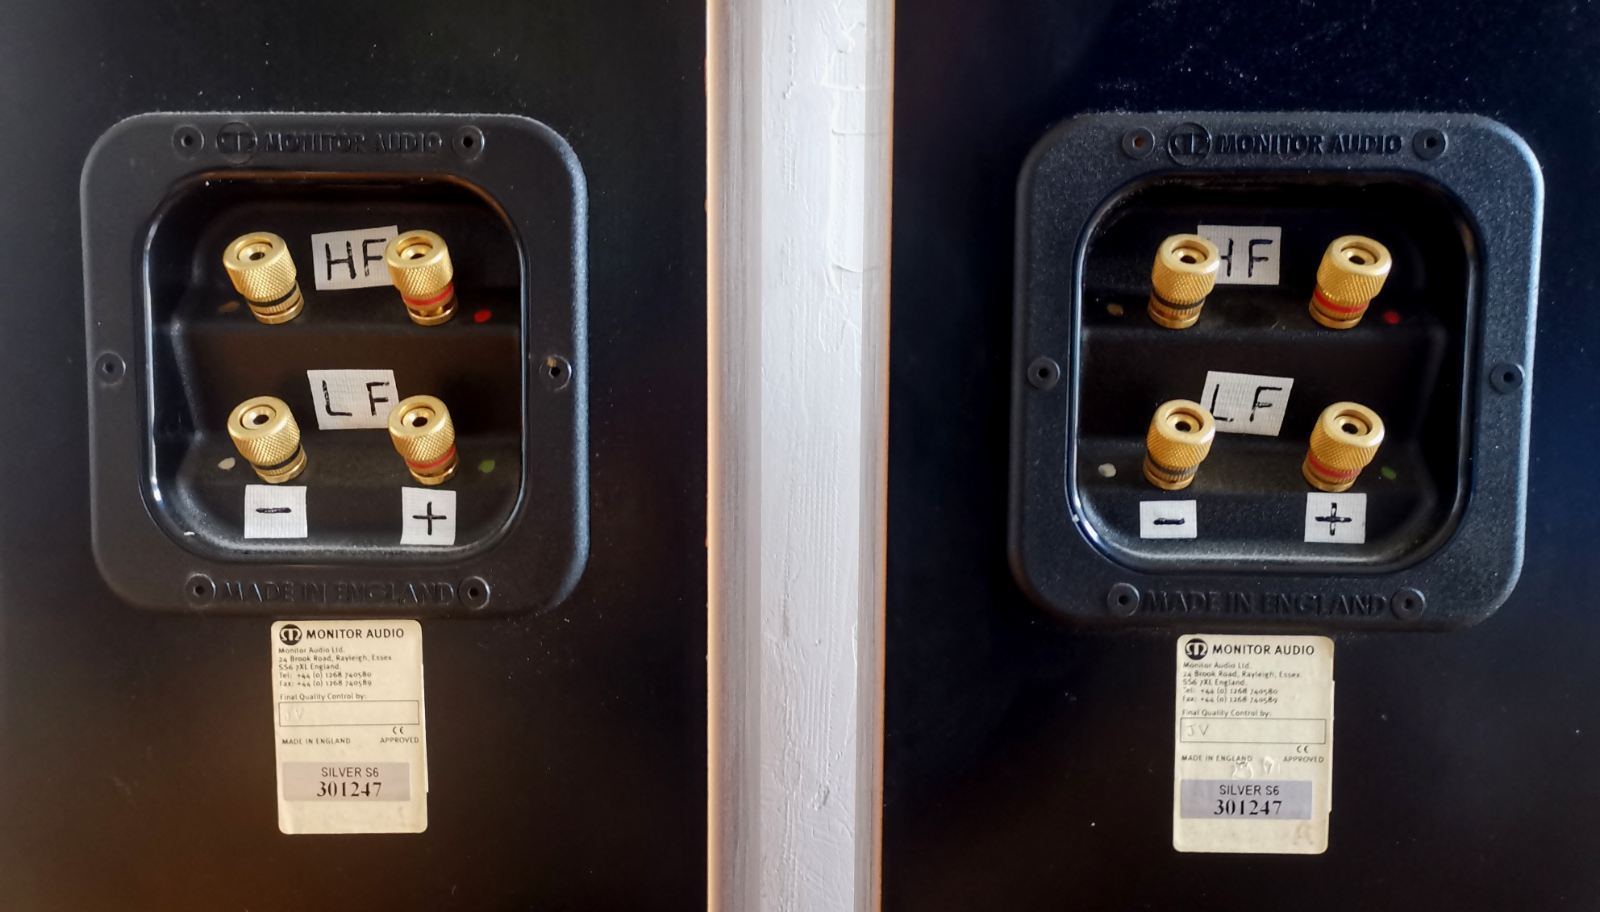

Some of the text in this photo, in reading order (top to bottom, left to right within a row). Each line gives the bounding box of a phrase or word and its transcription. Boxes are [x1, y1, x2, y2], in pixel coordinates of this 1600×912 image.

[266, 131, 443, 152] MONITOR AUDIO
[1215, 133, 1402, 154] MONITOR AUDIO
[324, 238, 388, 281] HF
[222, 582, 455, 604] MADE IN ENGLAND
[1146, 591, 1387, 616] MADE IN ENGLAND
[306, 628, 405, 640] MONITOR AUDIO
[278, 646, 307, 654] Monitor
[309, 646, 330, 654] Audio
[1212, 644, 1315, 656] MONITOR AUDIO
[1183, 661, 1212, 669] Monitor
[1214, 661, 1236, 669] Audio
[325, 671, 342, 679] 1268
[1229, 687, 1247, 695] 1268
[299, 693, 325, 702] Quality
[327, 693, 354, 701] Control
[1201, 709, 1229, 718] Quality
[1230, 709, 1258, 717] Control
[379, 736, 420, 744] APPROVED
[1216, 755, 1253, 763] ENGLAND
[1283, 756, 1325, 764] APPROVED
[321, 767, 379, 778] SILVER S6
[316, 781, 382, 798] 301247
[1219, 785, 1280, 796] SILVER S6
[1213, 799, 1283, 816] 301247
